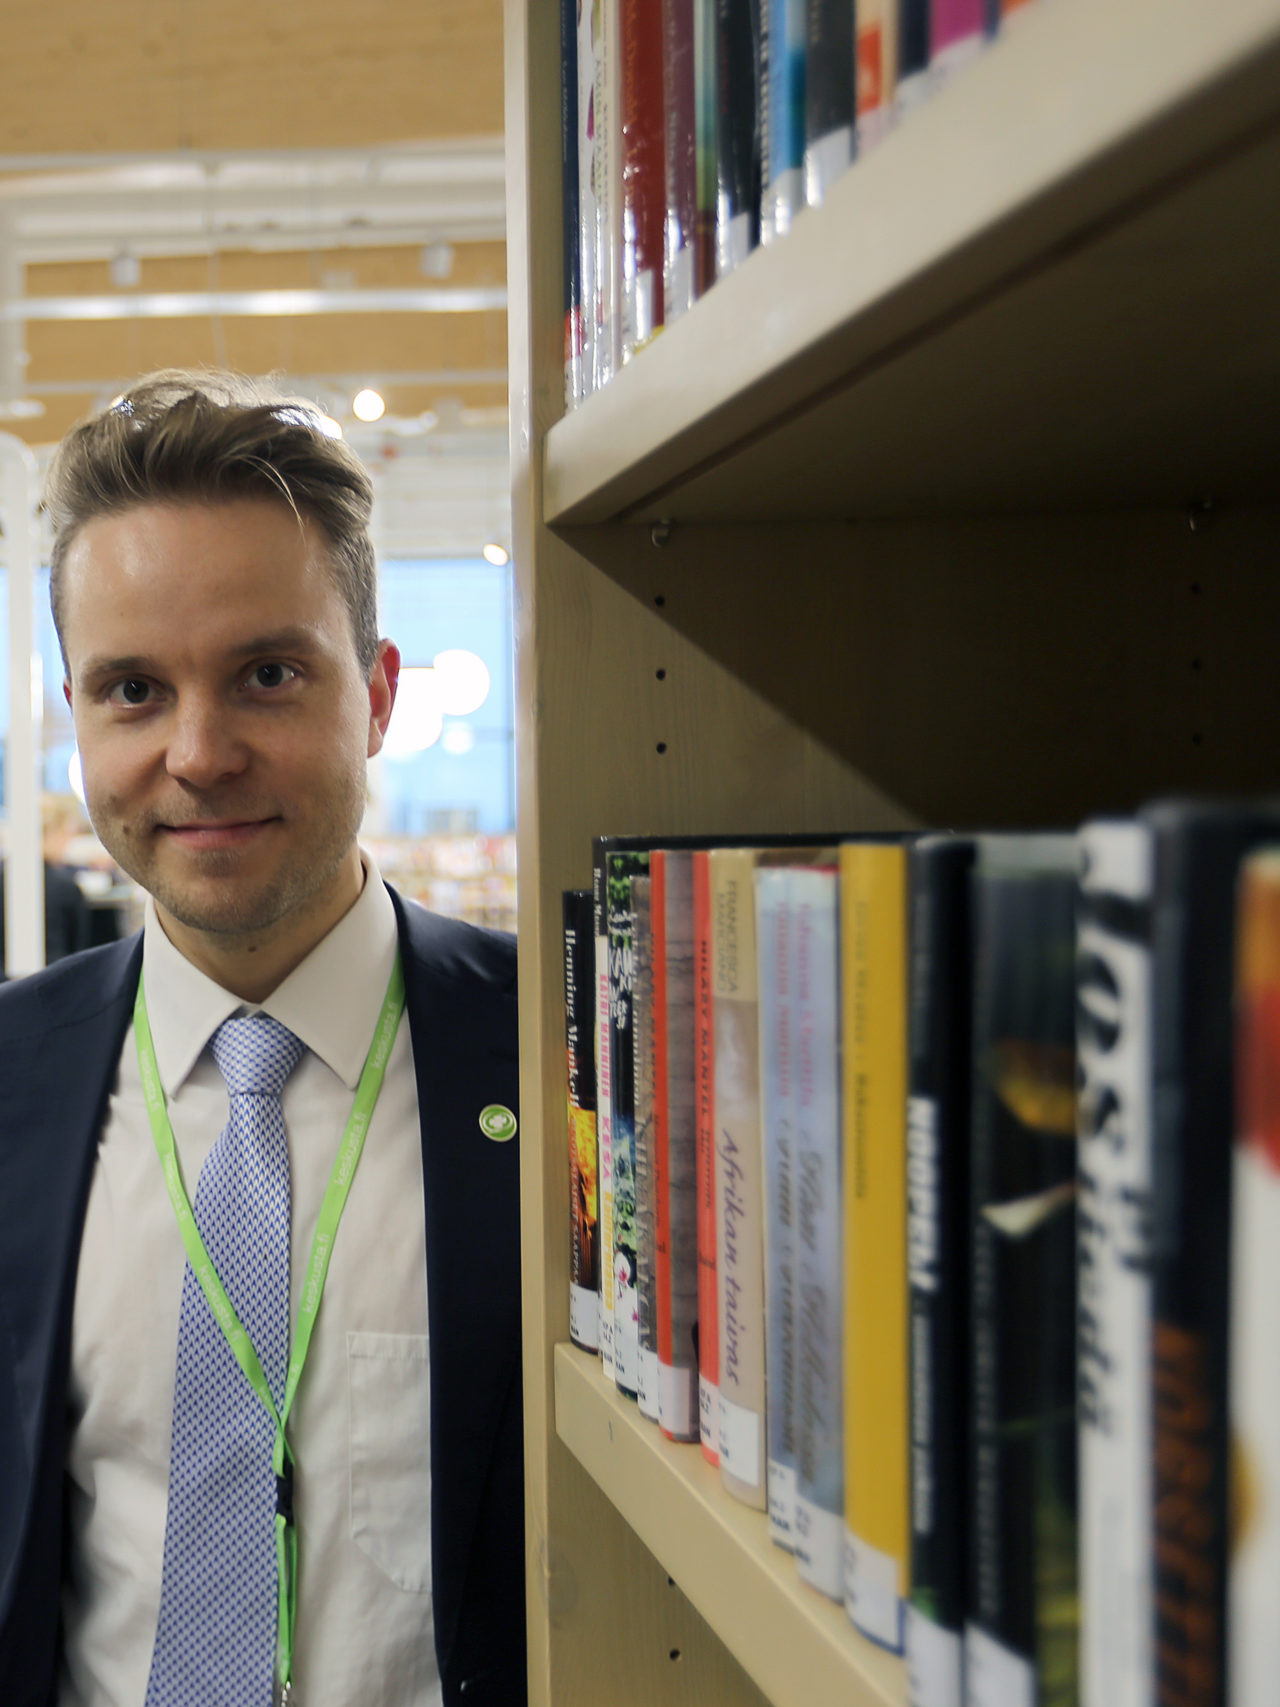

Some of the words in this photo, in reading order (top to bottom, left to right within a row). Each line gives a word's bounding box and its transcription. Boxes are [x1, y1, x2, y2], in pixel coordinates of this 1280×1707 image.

[565, 928, 578, 1020] Henning
[568, 1024, 581, 1109] Mankell
[334, 1111, 367, 1187] keskusta.fi
[302, 1232, 331, 1315] keskusta.fi
[572, 1223, 580, 1286] SAAPPAA
